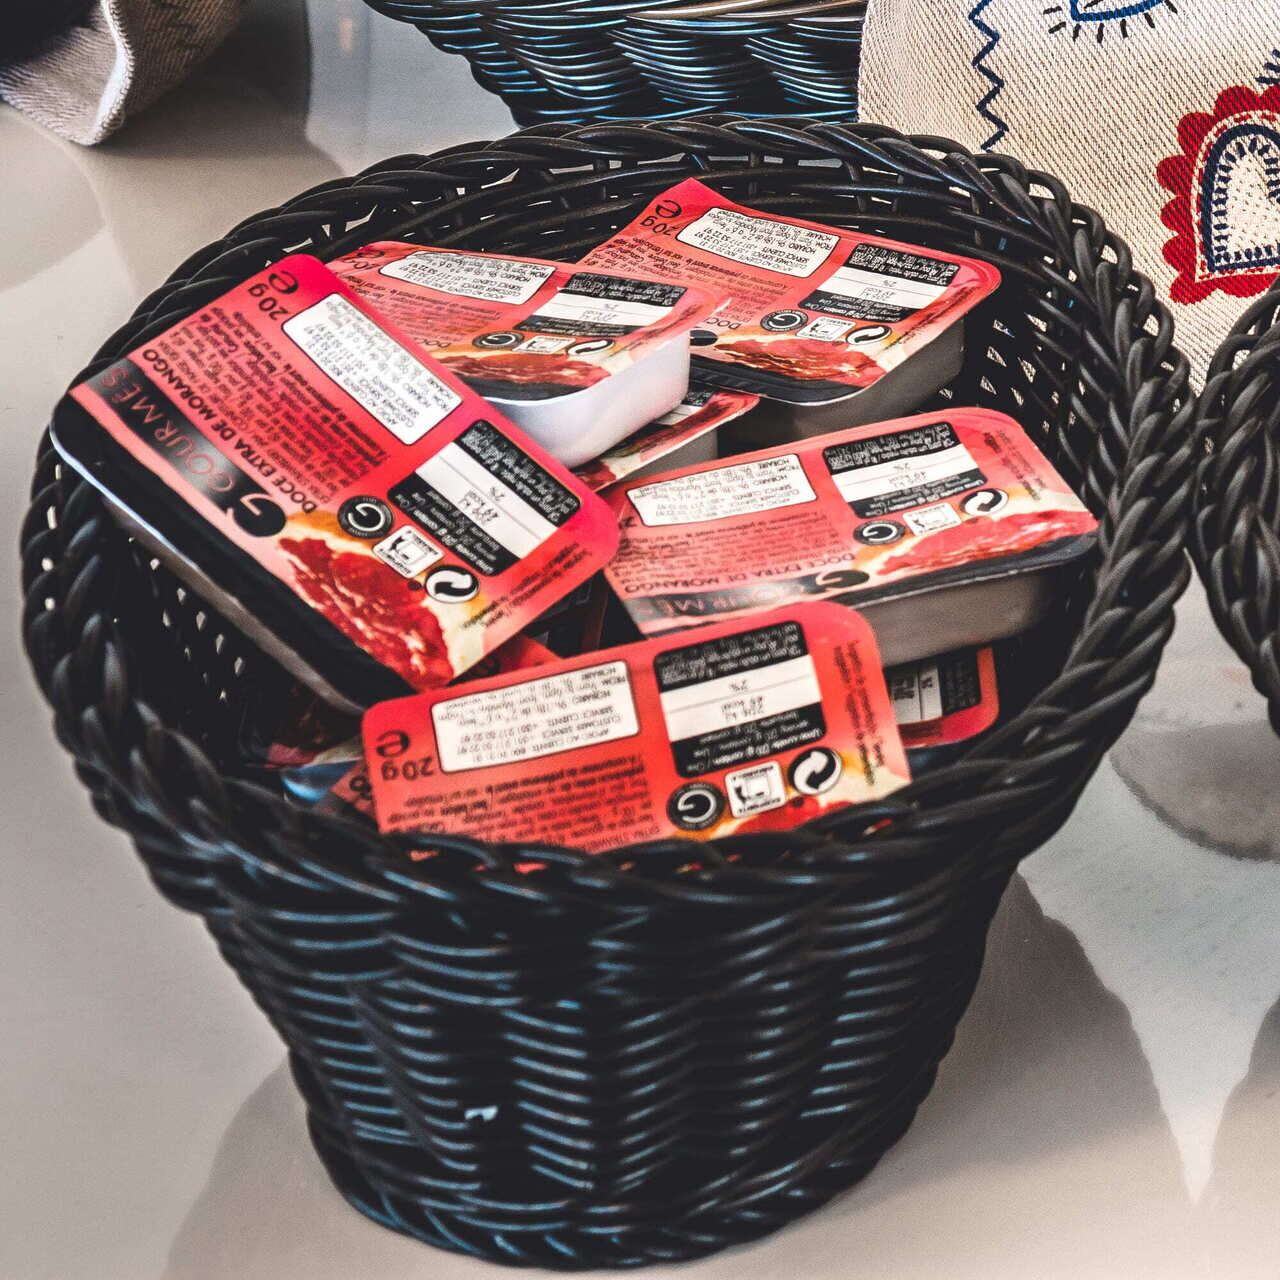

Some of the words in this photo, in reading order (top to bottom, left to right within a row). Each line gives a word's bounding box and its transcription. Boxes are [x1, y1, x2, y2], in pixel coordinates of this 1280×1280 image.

[141, 347, 216, 420] MORANGO
[101, 364, 235, 497] GOURMÊS
[213, 416, 236, 439] DE
[235, 437, 276, 477] EXTRA
[274, 474, 315, 515] DOCE
[750, 561, 800, 578] EXTRA
[806, 552, 854, 568] DOCE
[622, 575, 719, 594] MORANGO
